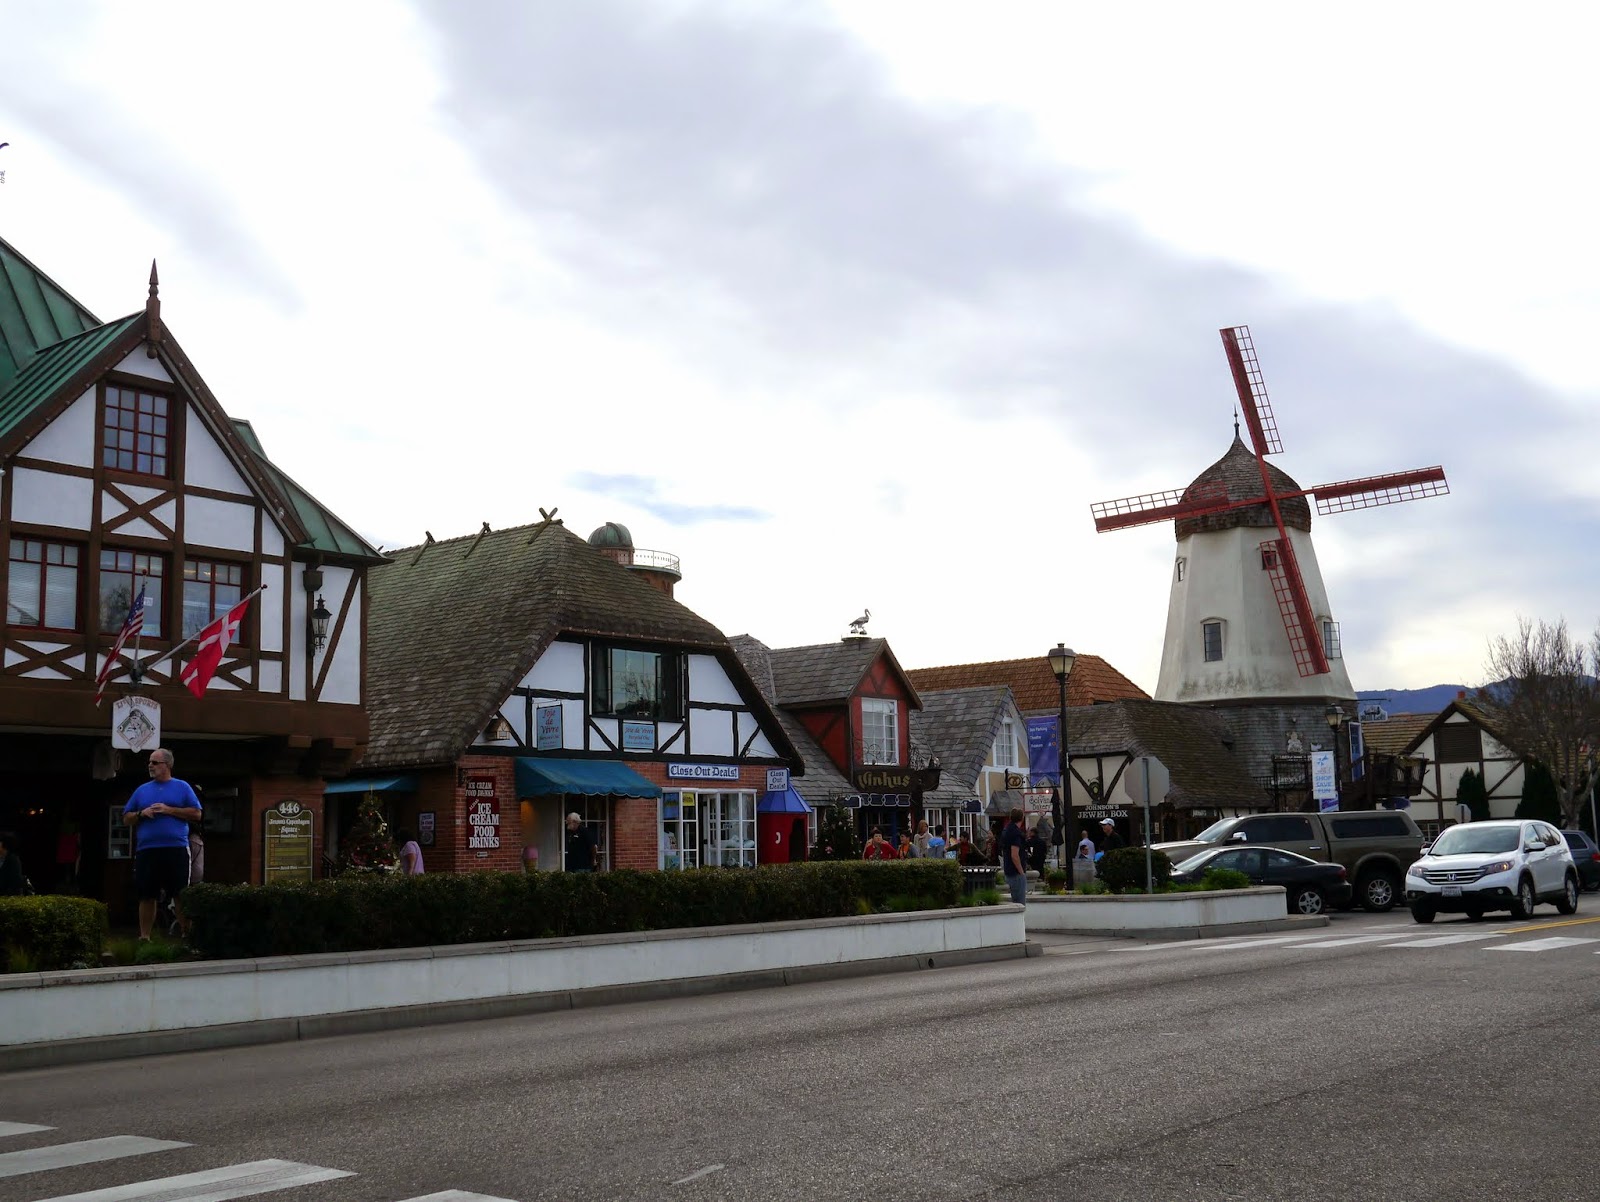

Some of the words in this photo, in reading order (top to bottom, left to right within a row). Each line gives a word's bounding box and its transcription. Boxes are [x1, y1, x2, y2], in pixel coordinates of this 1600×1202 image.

[670, 765, 694, 776] Close
[695, 765, 711, 776] Out
[712, 766, 737, 778] Deals!
[857, 771, 911, 789] Vinhus
[465, 789, 477, 797] FOOD
[477, 789, 494, 797] DRINKS
[279, 802, 300, 814] 446
[477, 803, 492, 814] ICE
[1085, 803, 1120, 811] JOHNSON'S
[469, 813, 500, 825] CREAM
[1077, 811, 1108, 819] JEWEL
[1110, 809, 1129, 818] BOX
[473, 825, 495, 837] FOOD
[468, 837, 500, 848] DRINKS
